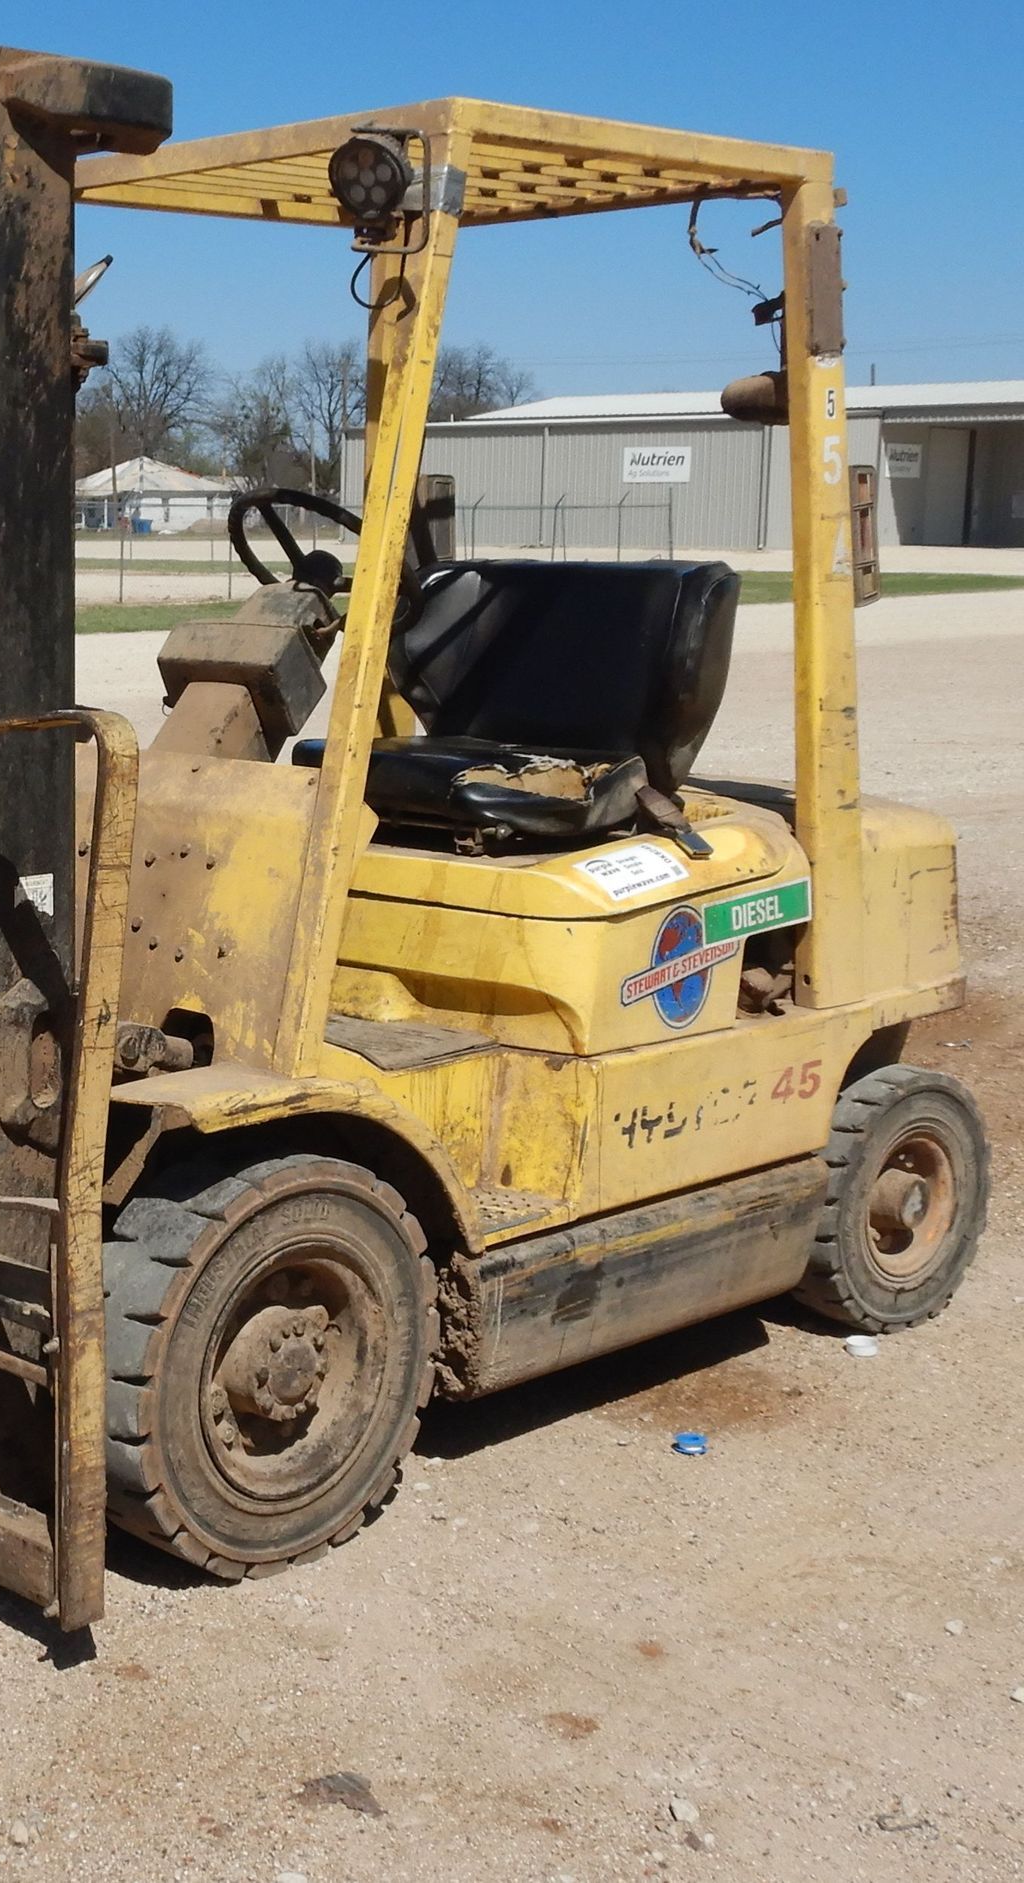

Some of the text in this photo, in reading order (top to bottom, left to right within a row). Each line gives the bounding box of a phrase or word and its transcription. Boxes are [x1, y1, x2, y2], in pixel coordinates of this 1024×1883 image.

[826, 389, 835, 418] 5
[629, 450, 685, 467] Nutrien
[823, 436, 842, 485] 5
[732, 895, 784, 931] DIESEL
[770, 1059, 822, 1105] 45
